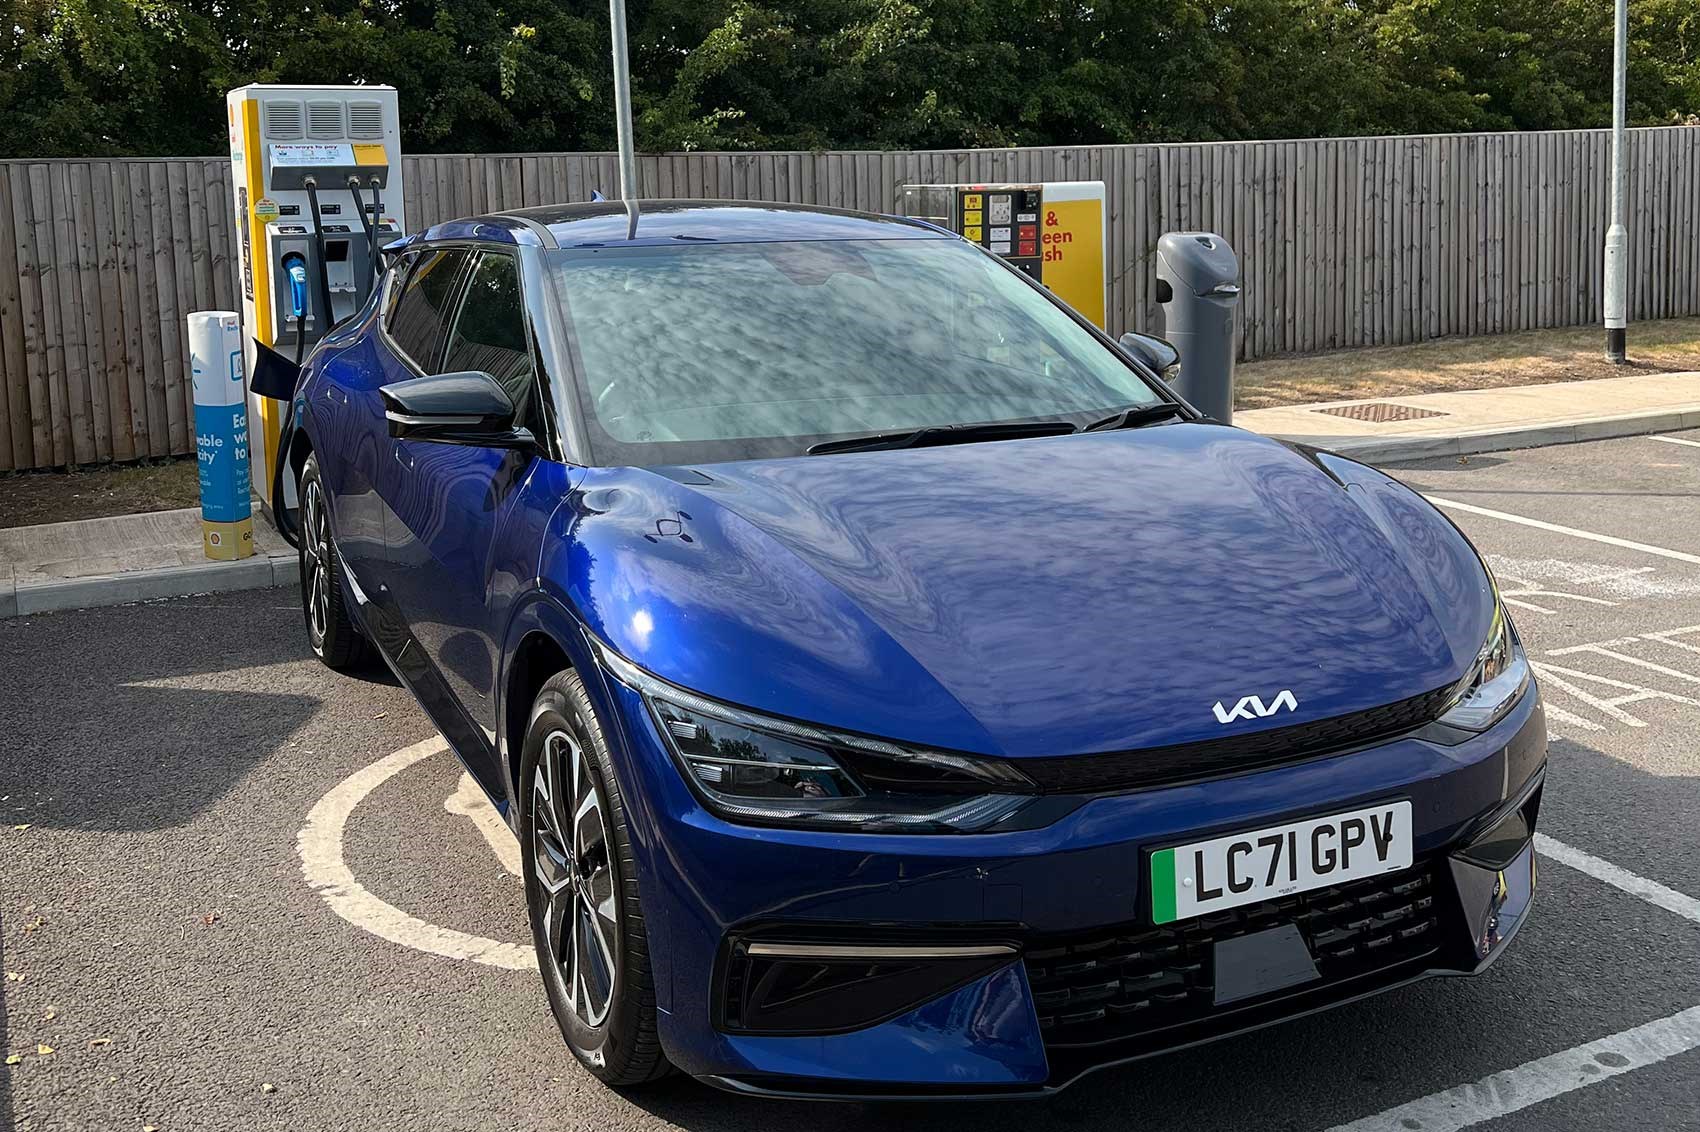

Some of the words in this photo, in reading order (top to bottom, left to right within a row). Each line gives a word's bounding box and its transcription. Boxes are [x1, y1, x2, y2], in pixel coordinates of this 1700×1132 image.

[1045, 211, 1059, 227] &
[1041, 245, 1063, 262] sh
[234, 447, 246, 460] to
[1212, 690, 1298, 723] KIA
[1195, 831, 1297, 902] LC71
[1311, 811, 1393, 875] GPV
